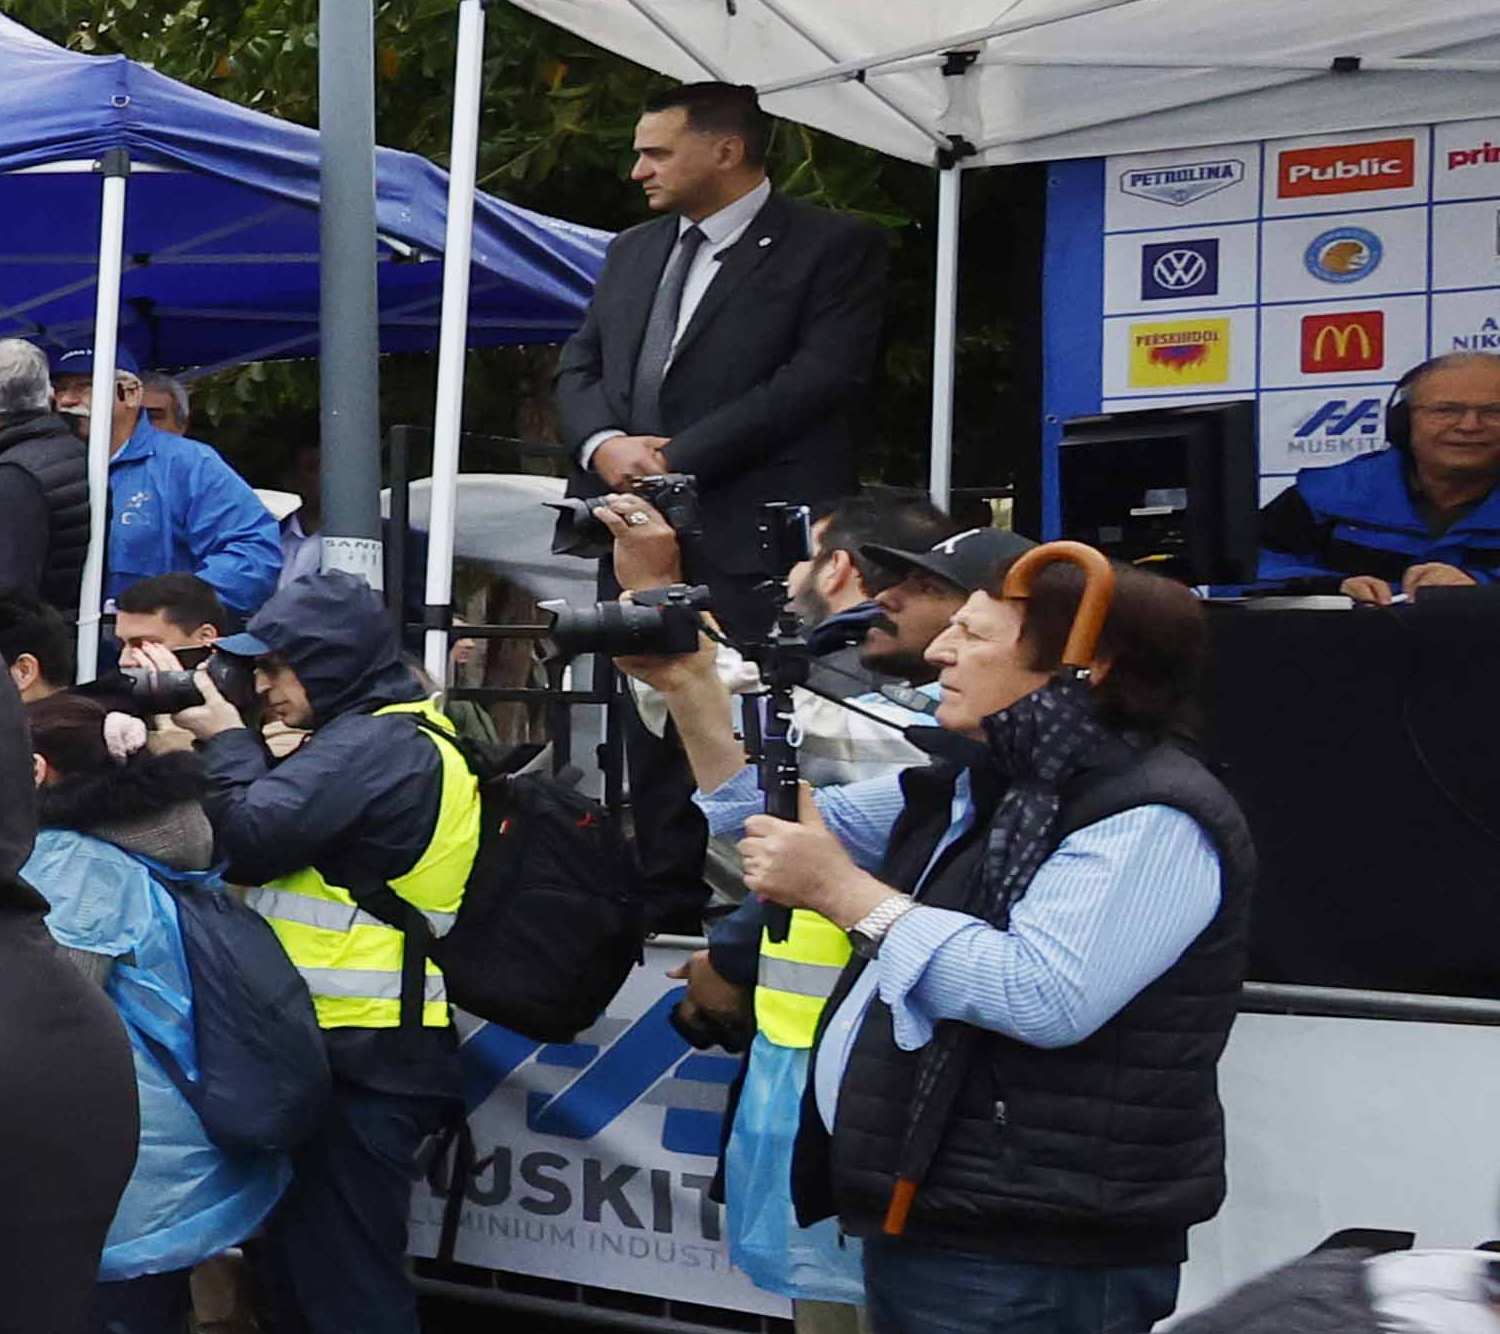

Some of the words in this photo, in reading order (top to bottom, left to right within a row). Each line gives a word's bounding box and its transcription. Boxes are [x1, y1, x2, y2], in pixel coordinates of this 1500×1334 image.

[1130, 164, 1234, 188] PETROLINA
[1289, 158, 1403, 184] Public
[589, 1232, 737, 1274] INDUST
